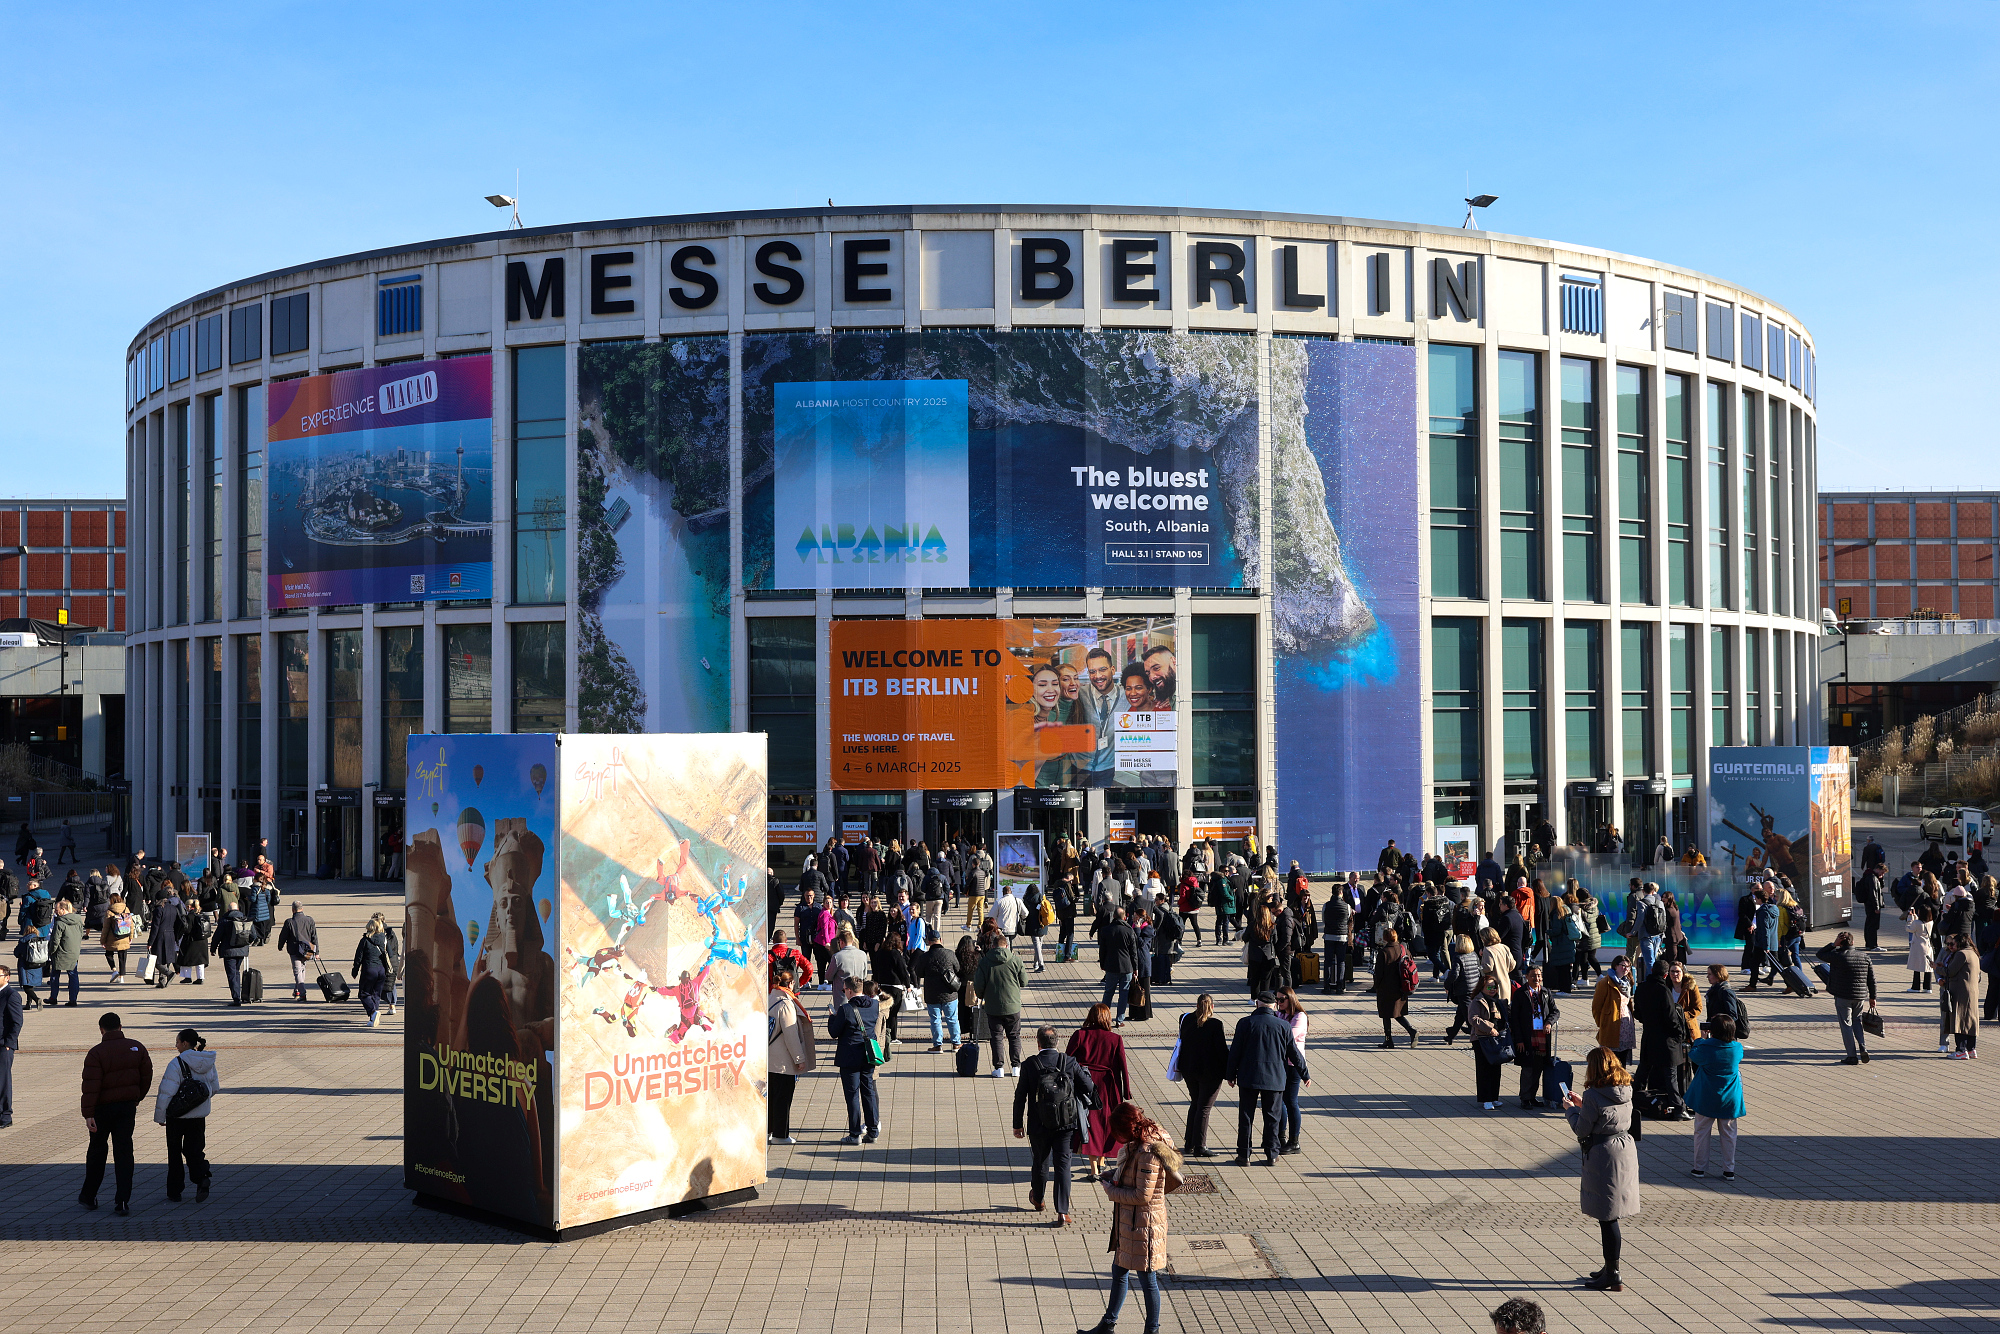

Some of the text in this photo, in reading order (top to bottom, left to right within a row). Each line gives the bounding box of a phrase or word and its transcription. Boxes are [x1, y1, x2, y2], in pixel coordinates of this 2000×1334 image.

[507, 237, 1477, 321] MESSE BERLIN
[301, 375, 433, 432] EXPERIENCE MACAO
[795, 397, 948, 408] ALBANIA HOST COUNTRY 2025
[1071, 466, 1209, 488] The bluest
[1091, 489, 1209, 511] welcome
[795, 522, 947, 549] ALBANIA
[1105, 519, 1209, 533] South, Albania
[851, 546, 948, 564] SENSES
[1111, 550, 1203, 558] HALL 3.1 STAND 105
[842, 649, 1002, 668] WELCOME TO
[843, 677, 978, 696] ITB BERLIN!
[842, 733, 955, 742] THE WORLD OF TRAVEL
[843, 745, 900, 754] LIVES HERE.
[843, 762, 850, 773] 4
[865, 762, 872, 773] 6
[877, 762, 926, 773] MARCH
[930, 762, 961, 773] 2025
[1714, 763, 1805, 774] GUATEMALA
[1811, 763, 1848, 775] GUATEMALA
[438, 1043, 537, 1082] Unmatched
[613, 1034, 747, 1077] Unmatched
[419, 1052, 537, 1110] DIVERSITY
[585, 1060, 746, 1111] DIVERSITY
[414, 1162, 466, 1184] #ExperienceEgypt
[576, 1179, 653, 1202] #ExperienceEgypt
